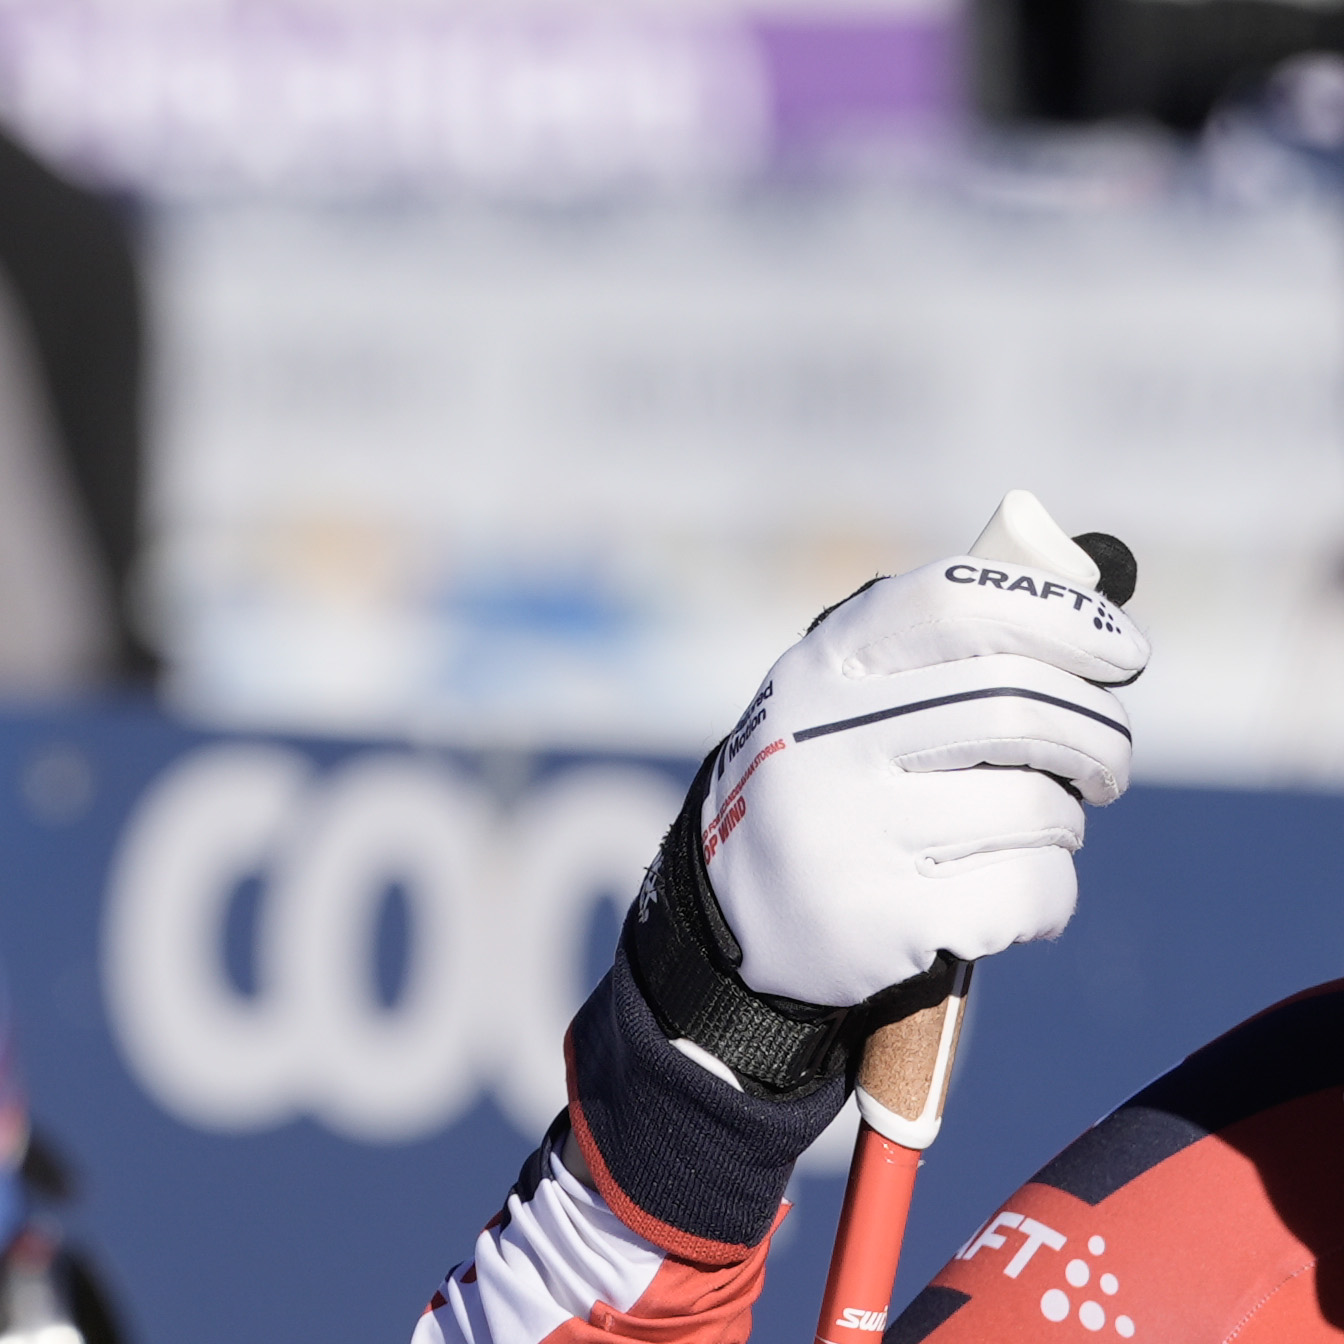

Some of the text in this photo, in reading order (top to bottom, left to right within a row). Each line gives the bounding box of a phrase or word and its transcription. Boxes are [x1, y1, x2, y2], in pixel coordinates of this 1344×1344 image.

[945, 564, 1093, 612] CRAFT
[729, 707, 766, 763] Motion
[718, 795, 747, 845] WIND
